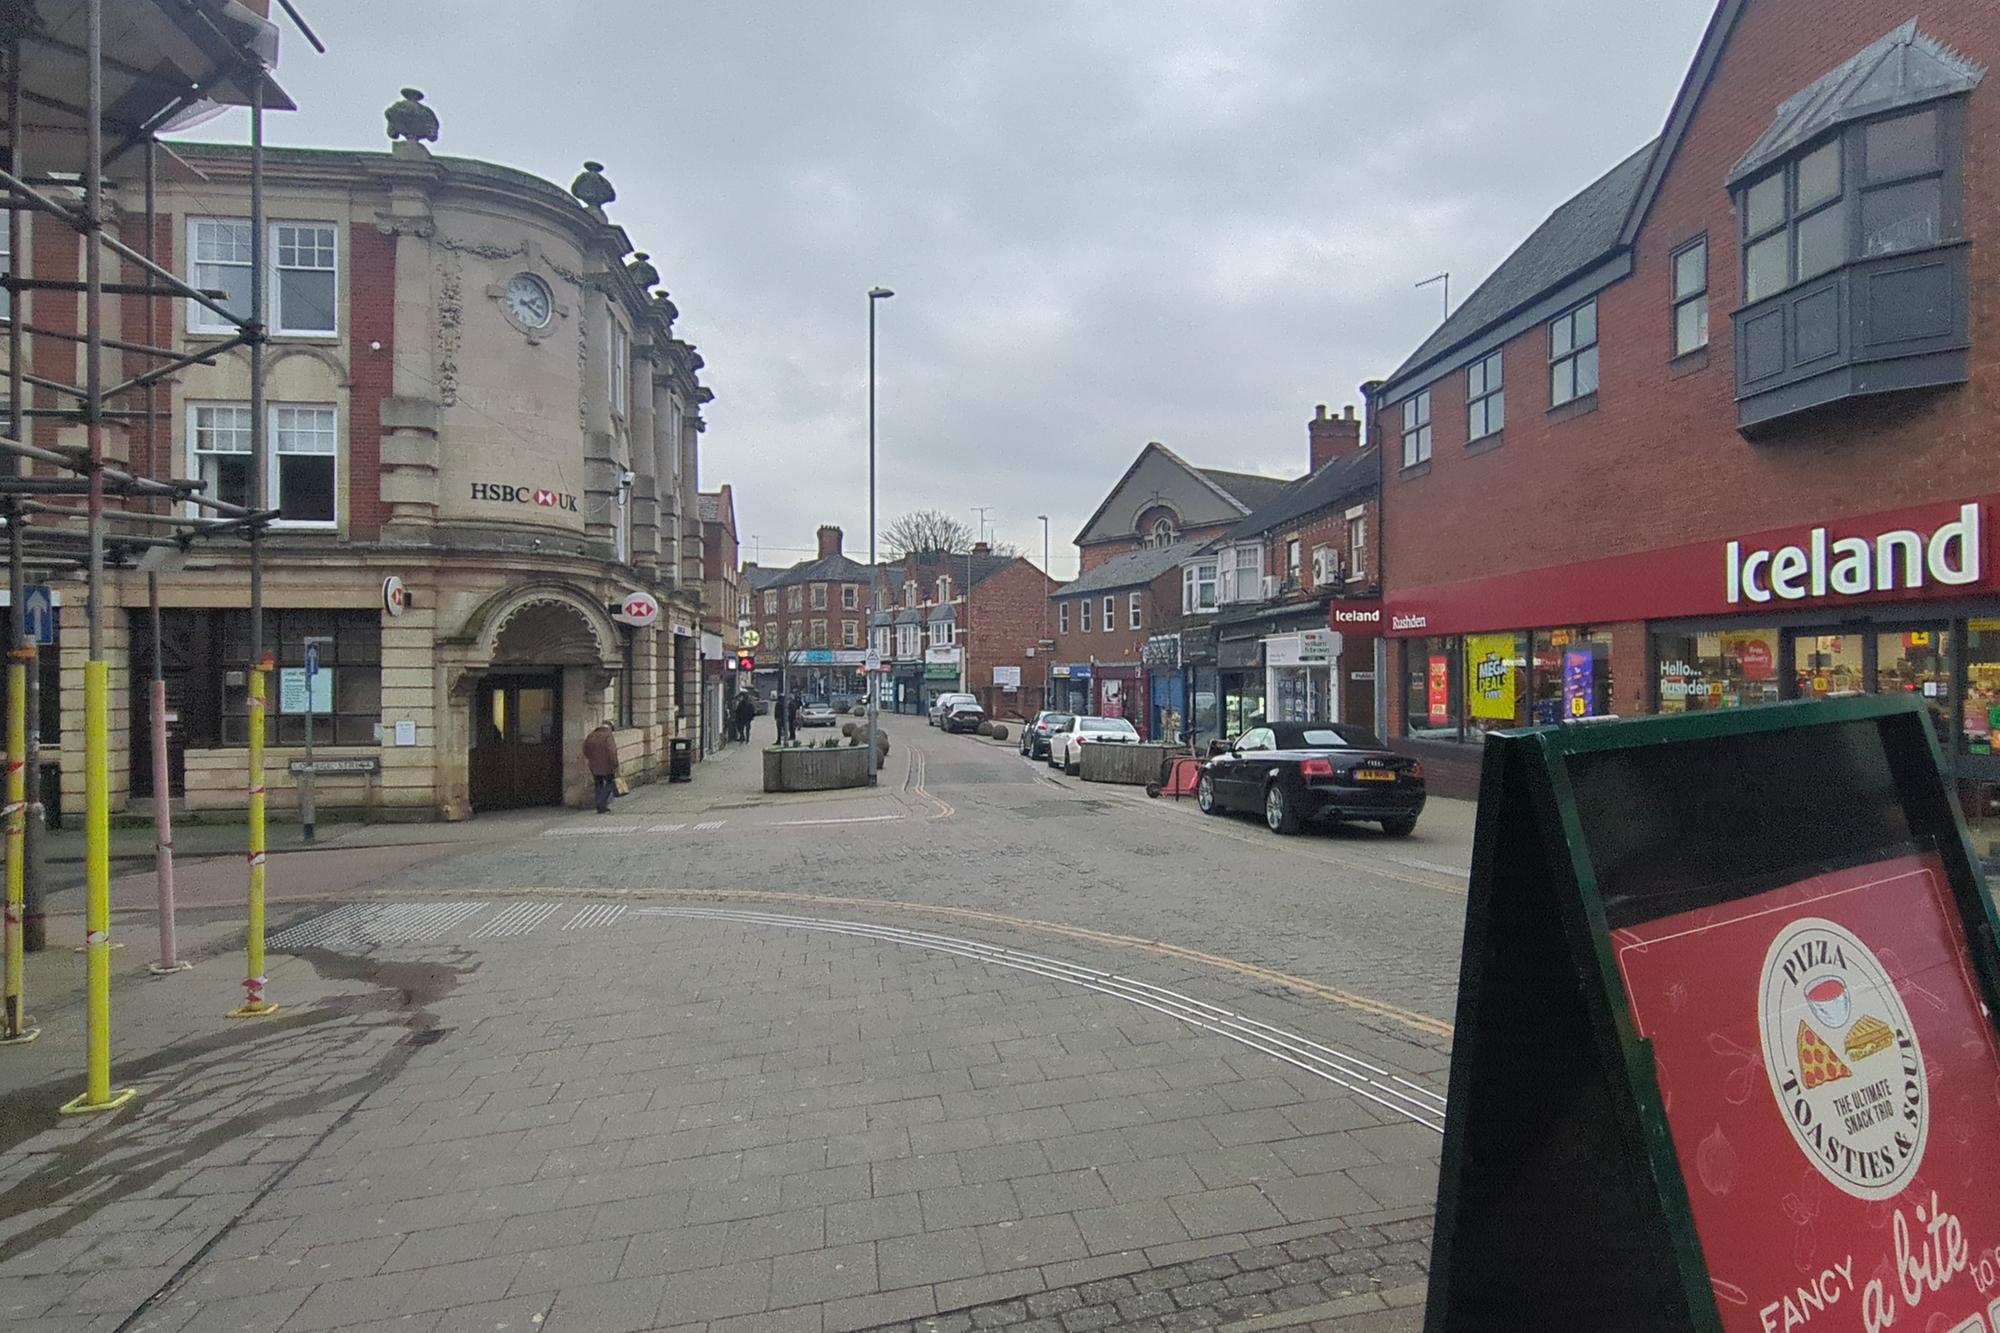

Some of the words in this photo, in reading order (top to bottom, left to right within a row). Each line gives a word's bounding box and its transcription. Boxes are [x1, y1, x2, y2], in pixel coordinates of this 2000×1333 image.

[470, 482, 530, 503] HSBC
[558, 492, 578, 512] UK
[1727, 502, 1980, 604] Iceland
[1335, 610, 1380, 622] Iceland
[1392, 614, 1427, 630] Rushden
[1479, 660, 1507, 679] MEGA
[1479, 674, 1506, 693] DEALS
[1660, 679, 1711, 694] Rushden
[1782, 940, 1848, 987] PIZZA
[1896, 1028, 1920, 1129] SOUP
[1833, 1097, 1854, 1118] THE
[1852, 1078, 1893, 1112] ULTIMATE
[1782, 1069, 1895, 1180] TOASTIES
[1844, 1106, 1876, 1136] SNACK
[1875, 1099, 1895, 1123] TRIO
[1894, 1131, 1913, 1161] &
[1760, 1254, 1853, 1333] FANCY
[1862, 1277, 1895, 1333] a
[1893, 1189, 1968, 1307] bite
[1968, 1259, 1995, 1293] to
